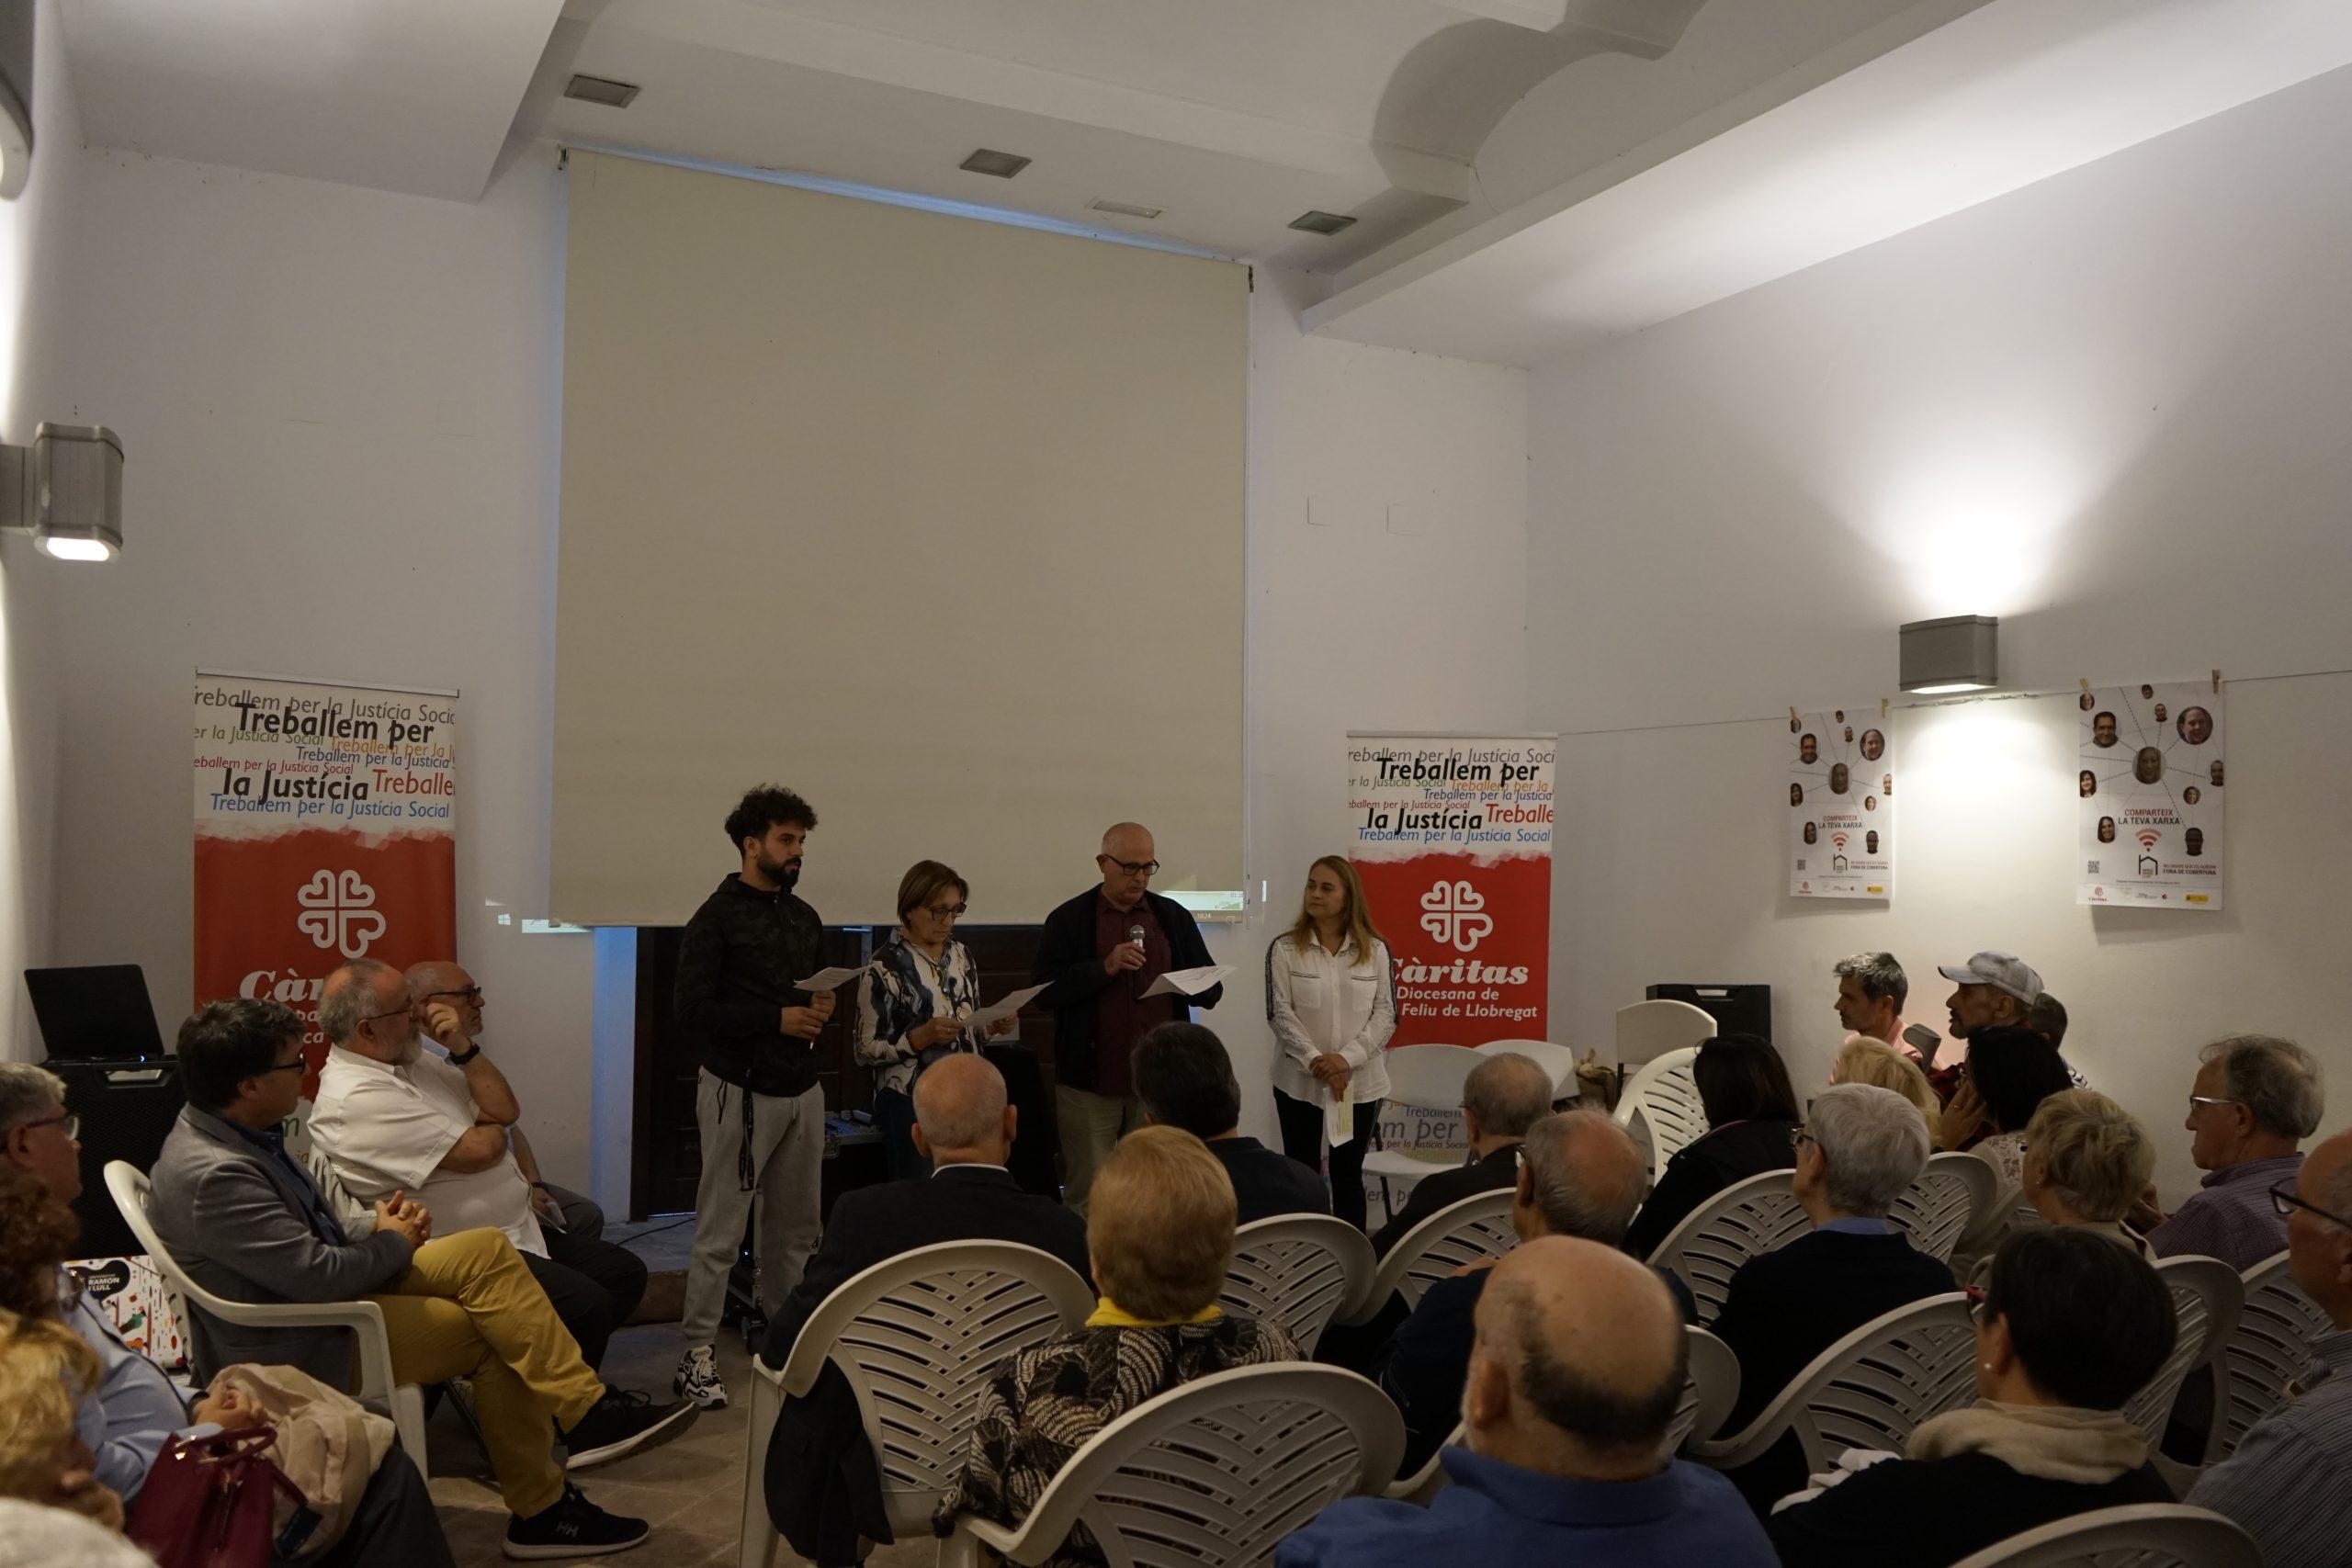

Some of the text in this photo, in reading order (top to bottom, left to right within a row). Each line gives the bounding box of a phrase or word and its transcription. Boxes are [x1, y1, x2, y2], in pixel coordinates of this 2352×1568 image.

[194, 686, 280, 711] reballem
[289, 696, 322, 716] per
[327, 696, 343, 716] la
[349, 698, 411, 721] Justícia
[235, 702, 435, 750] Treballem per
[212, 725, 226, 740] la
[285, 732, 324, 746] Social
[296, 746, 360, 763] Treballem
[365, 753, 388, 768] per
[391, 751, 402, 766] la
[404, 742, 429, 760] per
[431, 743, 445, 759] la
[1418, 750, 1443, 764] per
[1449, 748, 1462, 762] la
[1468, 748, 1520, 766] Justícia
[243, 760, 263, 773] per
[266, 760, 277, 772] la
[322, 762, 354, 775] Social
[1376, 757, 1491, 781] Treballem
[1499, 762, 1540, 788] per
[223, 768, 369, 807] la Justícia
[1360, 775, 1370, 787] la
[1513, 781, 1535, 795] per
[1537, 779, 1548, 792] la
[1423, 788, 1476, 800] Treballem
[1480, 791, 1499, 804] per
[1502, 790, 1512, 801] la
[210, 794, 450, 820] Treballem per la Justícia Social
[1383, 801, 1398, 811] per
[1401, 800, 1408, 809] la
[1445, 800, 1471, 809] Social
[2124, 808, 2174, 818] COMPARTEIX
[1367, 807, 1483, 836] la Justícia
[2118, 817, 2180, 826] LA TEVA XARXA
[1358, 828, 1419, 840] Treballem
[1424, 830, 1447, 845] per
[1452, 829, 1463, 841] la
[1516, 829, 1552, 842] Social
[1396, 986, 1500, 1000] Diocesana de
[1401, 1002, 1538, 1022] Feliu de Llobregat
